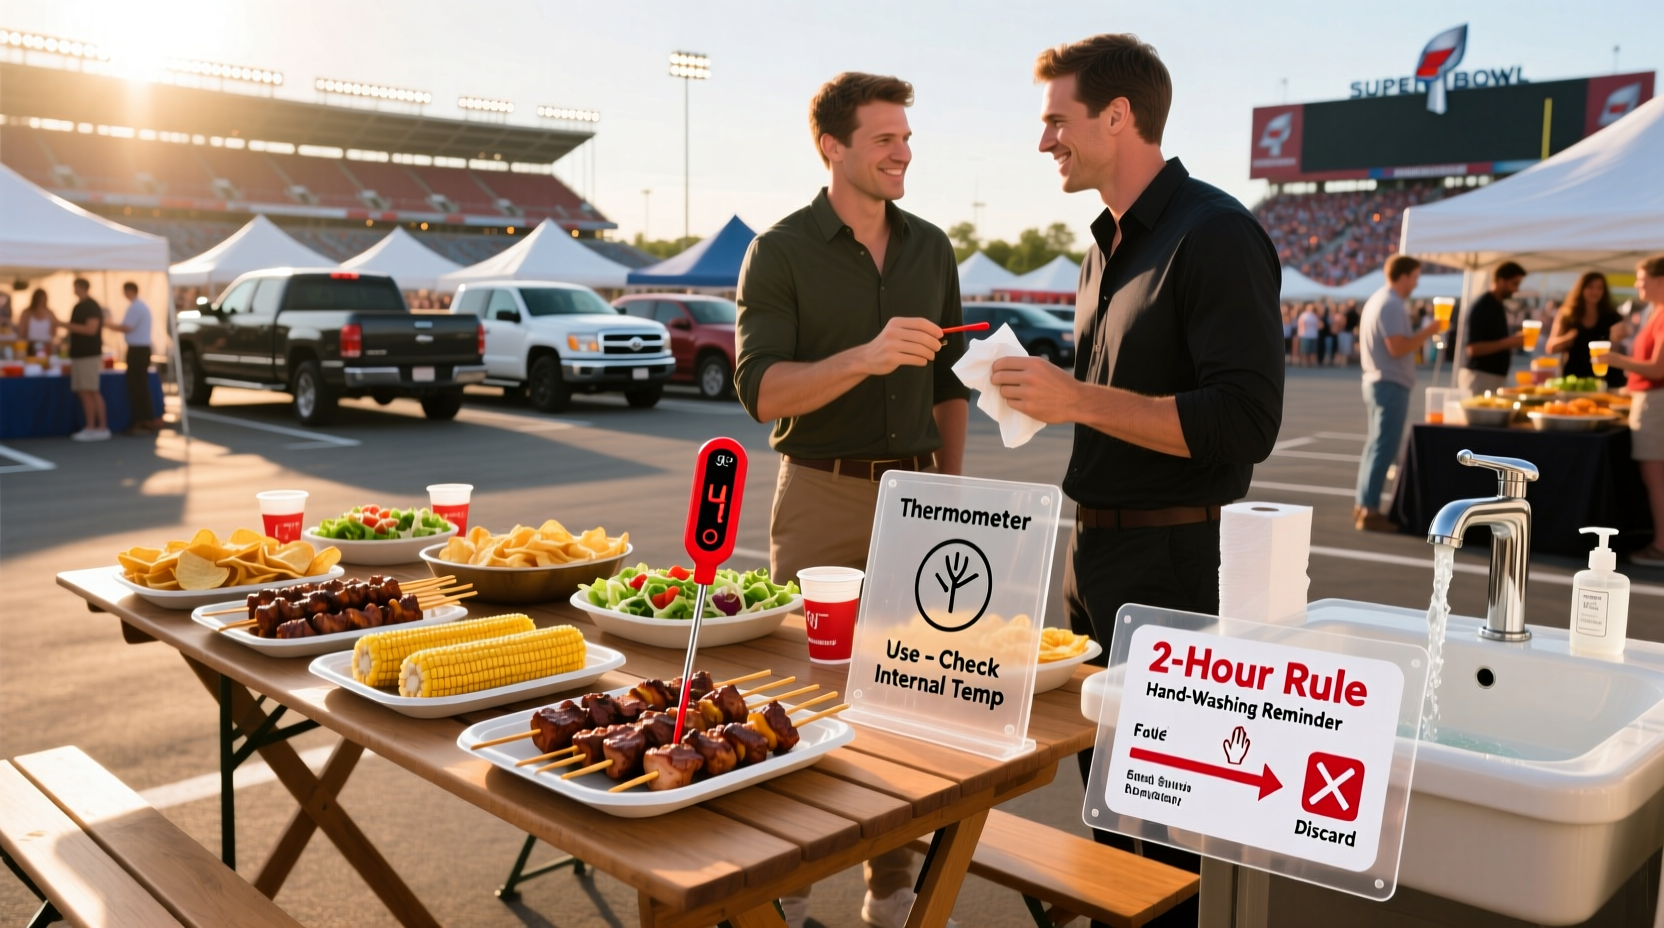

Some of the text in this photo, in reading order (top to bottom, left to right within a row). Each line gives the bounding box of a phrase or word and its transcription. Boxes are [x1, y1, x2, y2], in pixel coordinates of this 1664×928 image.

[1454, 66, 1530, 89] BOWL
[900, 497, 1032, 531] Thermometer
[886, 639, 920, 663] Use
[939, 649, 1000, 679] Check
[1148, 641, 1368, 707] 2-Hour Rule
[874, 664, 1004, 711] Internal Temp
[1145, 682, 1343, 731] Hand-Washing Reminder
[1294, 820, 1357, 848] Discard
